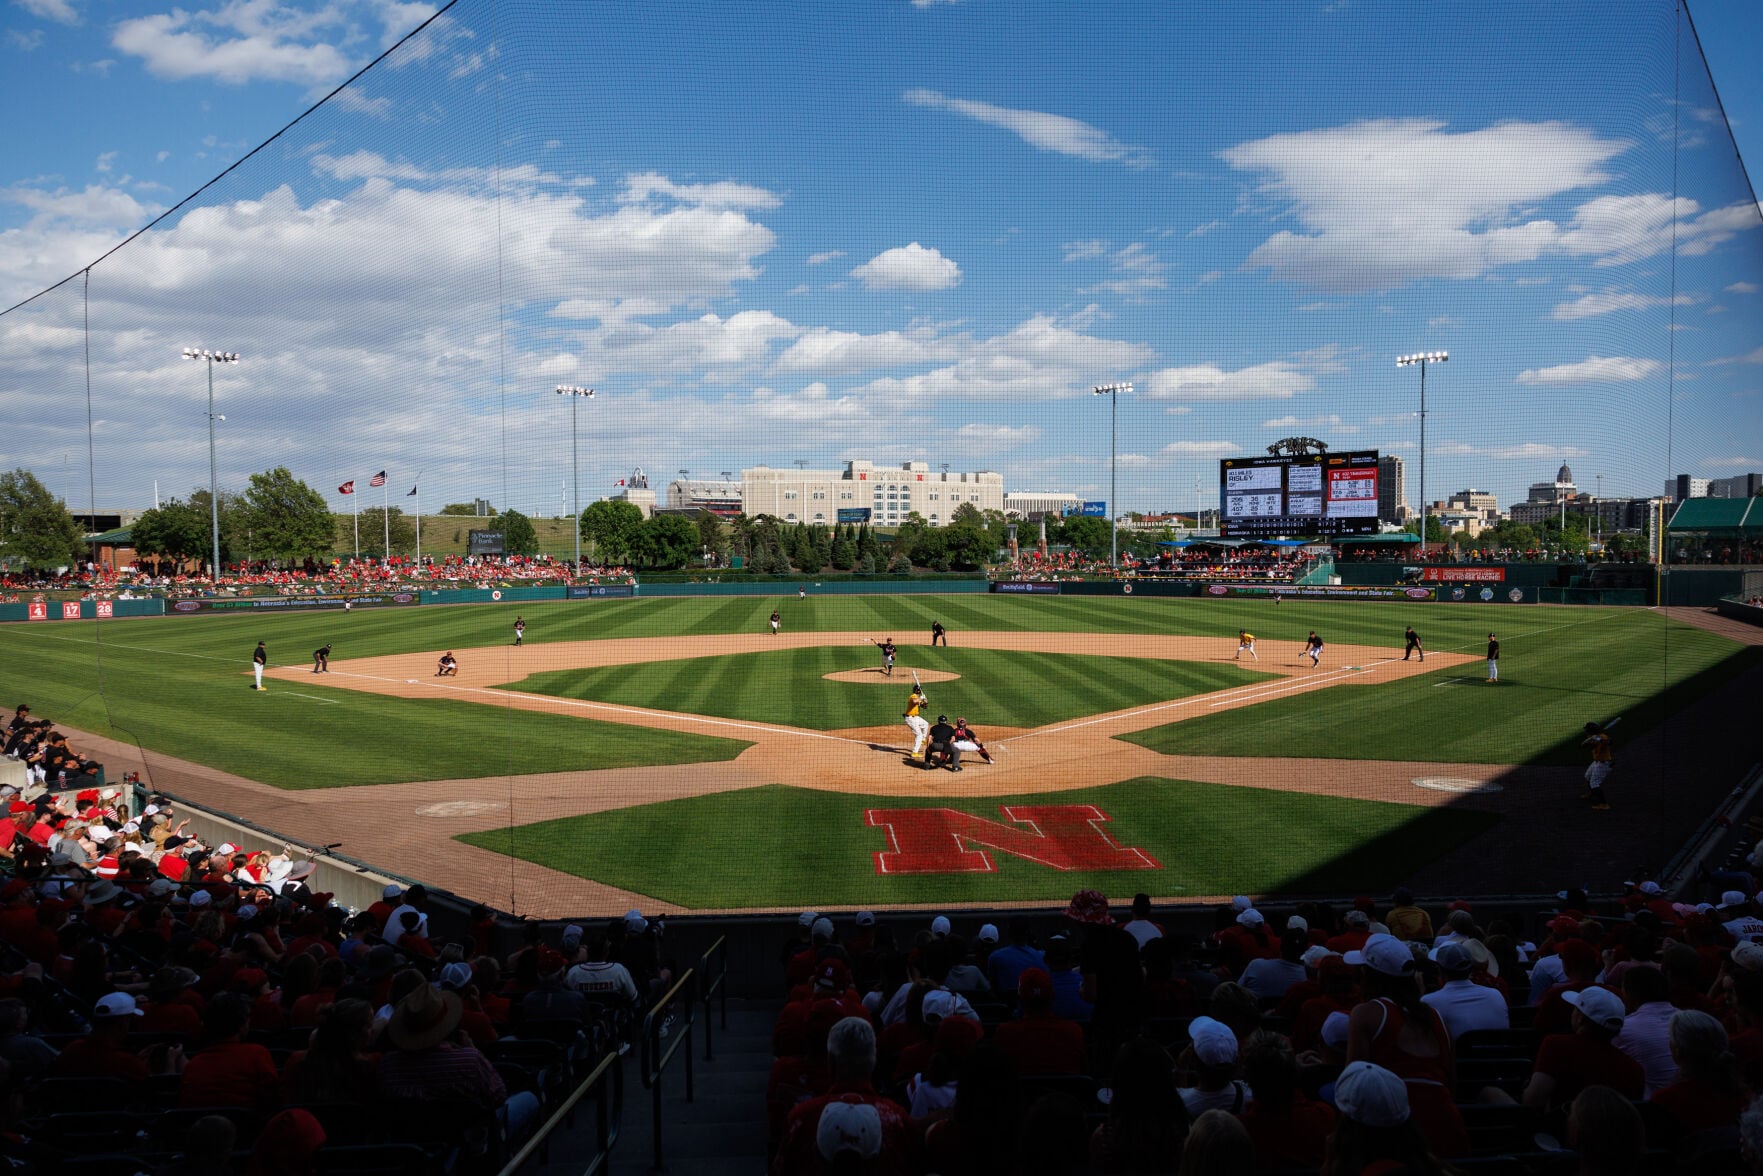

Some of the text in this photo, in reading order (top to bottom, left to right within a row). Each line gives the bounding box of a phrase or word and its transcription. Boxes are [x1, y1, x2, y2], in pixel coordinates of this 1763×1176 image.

[34, 608, 43, 616] 4
[66, 606, 78, 615] 17
[98, 605, 112, 614] 28
[863, 804, 1164, 875] N
